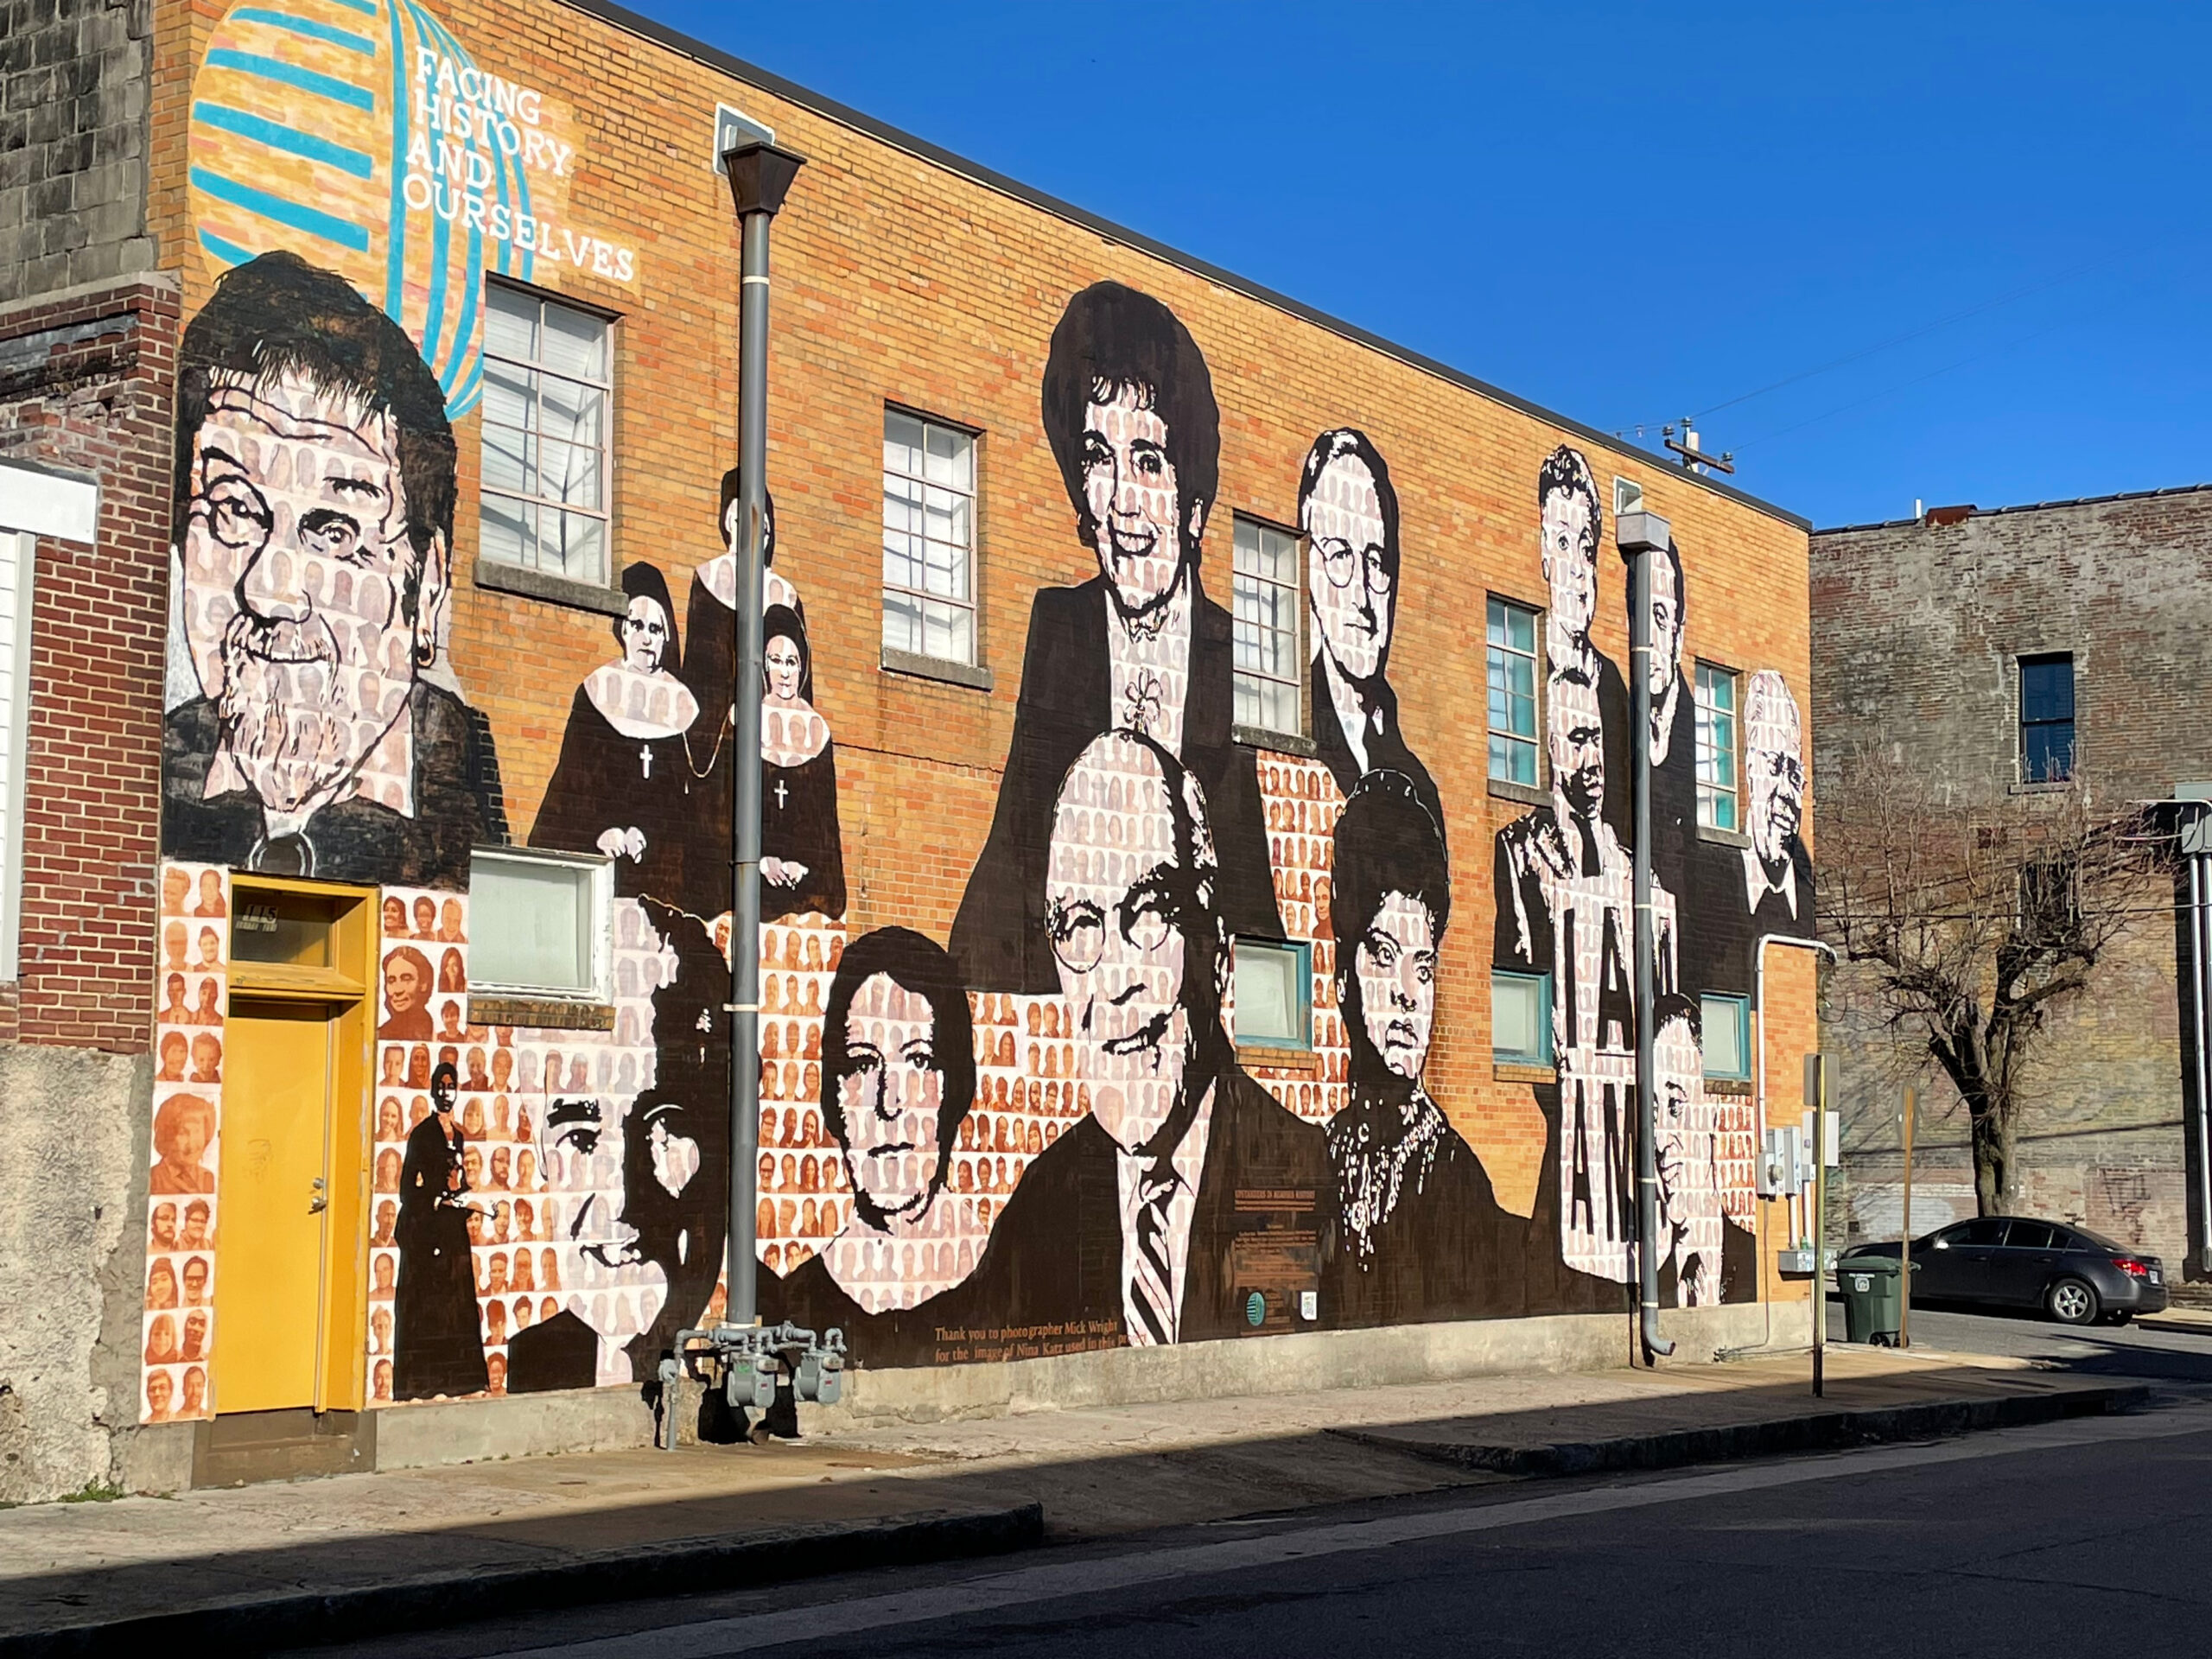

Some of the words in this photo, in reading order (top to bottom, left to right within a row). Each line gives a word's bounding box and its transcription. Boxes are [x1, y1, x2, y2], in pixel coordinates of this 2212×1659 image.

[415, 45, 542, 124] FACING
[405, 132, 492, 189] AND
[414, 88, 577, 176] HISTORY
[403, 173, 633, 282] OURSELVES
[247, 905, 277, 921] 115
[1564, 908, 1577, 1049] I
[1571, 1078, 1594, 1236] A
[935, 1325, 966, 1341] Thank
[969, 1329, 986, 1344] you
[988, 1329, 999, 1340] to
[1001, 1321, 1063, 1343] photographer
[1065, 1320, 1086, 1335] Mick
[1088, 1319, 1117, 1336] Wright
[935, 1348, 950, 1363] for
[952, 1346, 969, 1360] the
[974, 1345, 1002, 1362] image
[1017, 1343, 1039, 1356] Nina
[1042, 1342, 1064, 1356] Katz
[1065, 1337, 1086, 1352] used
[1088, 1337, 1097, 1350] in
